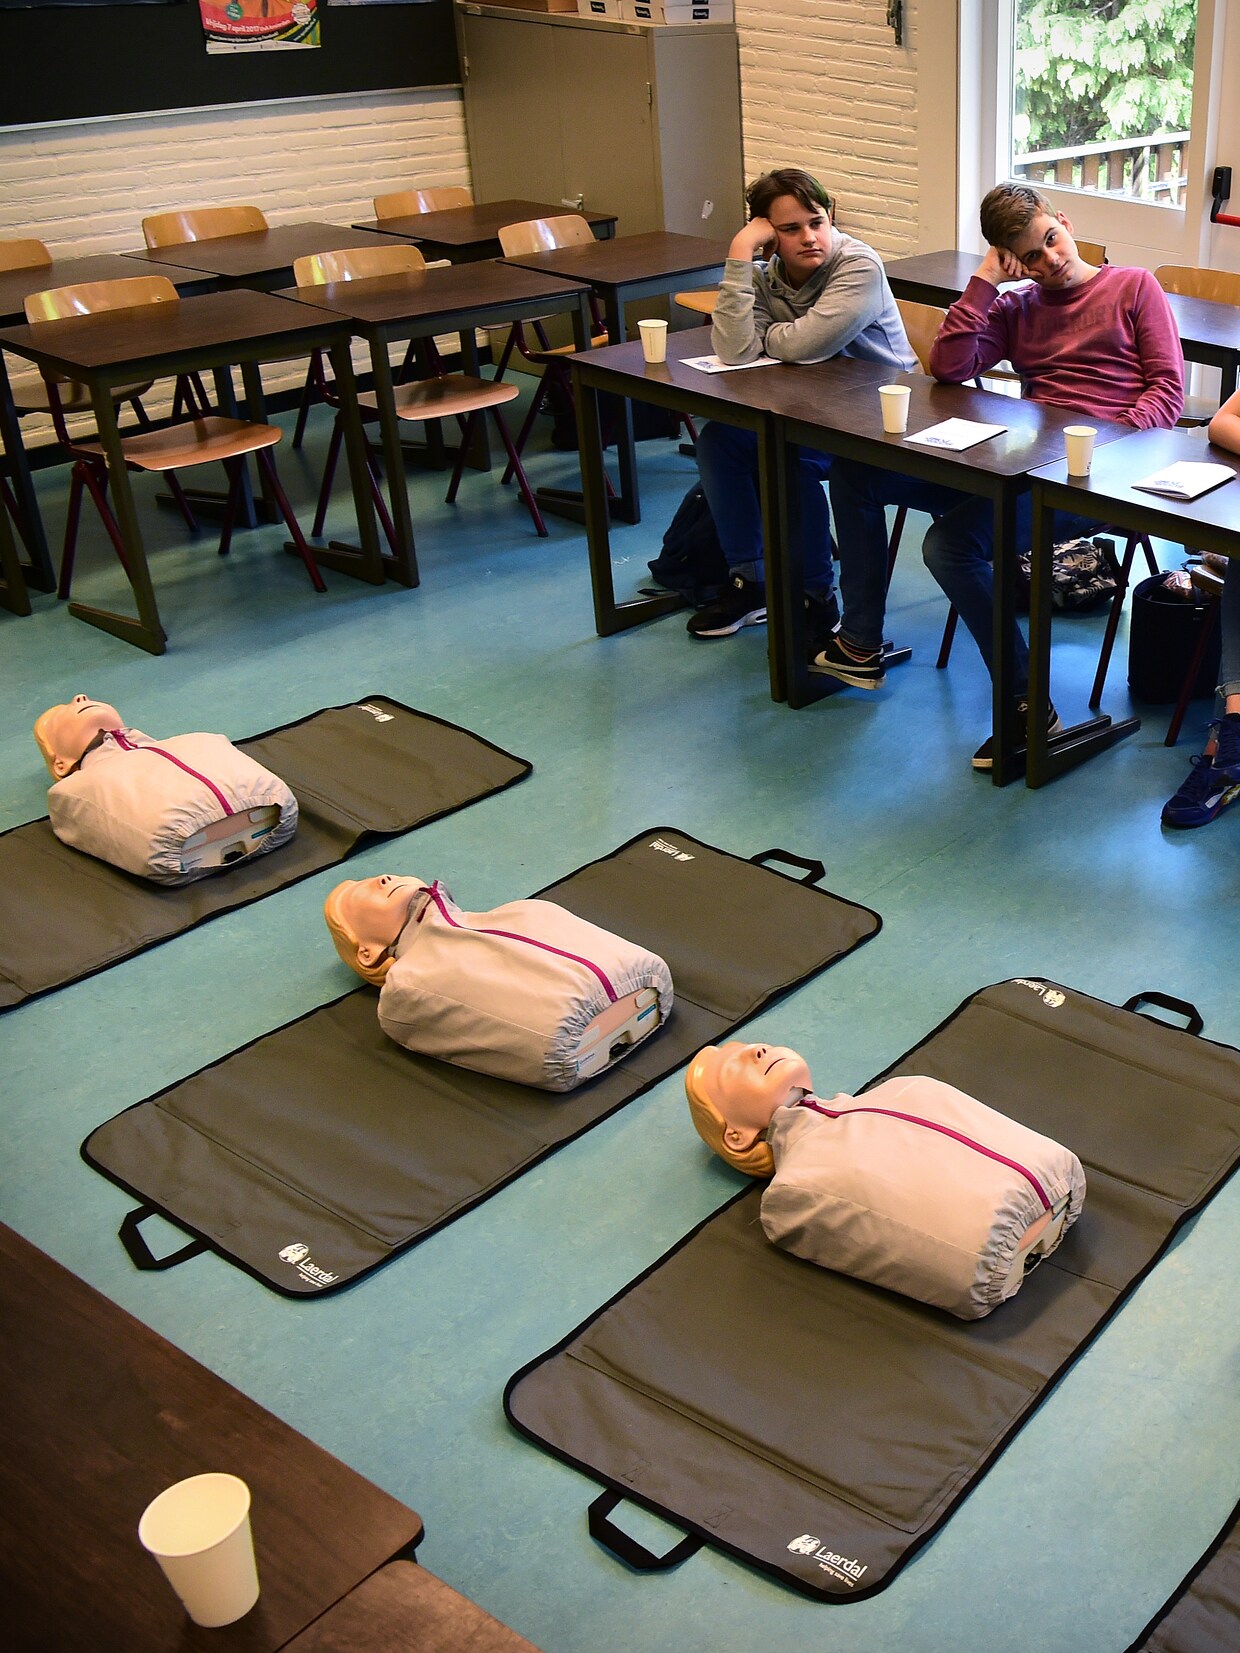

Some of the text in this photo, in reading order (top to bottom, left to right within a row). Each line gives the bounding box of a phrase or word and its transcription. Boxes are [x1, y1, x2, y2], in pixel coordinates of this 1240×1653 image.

[205, 17, 227, 31] Vrijdag
[231, 24, 246, 33] april
[245, 25, 260, 33] 2017
[299, 1257, 340, 1283] Laerdal
[815, 1546, 868, 1578] Laerdal
